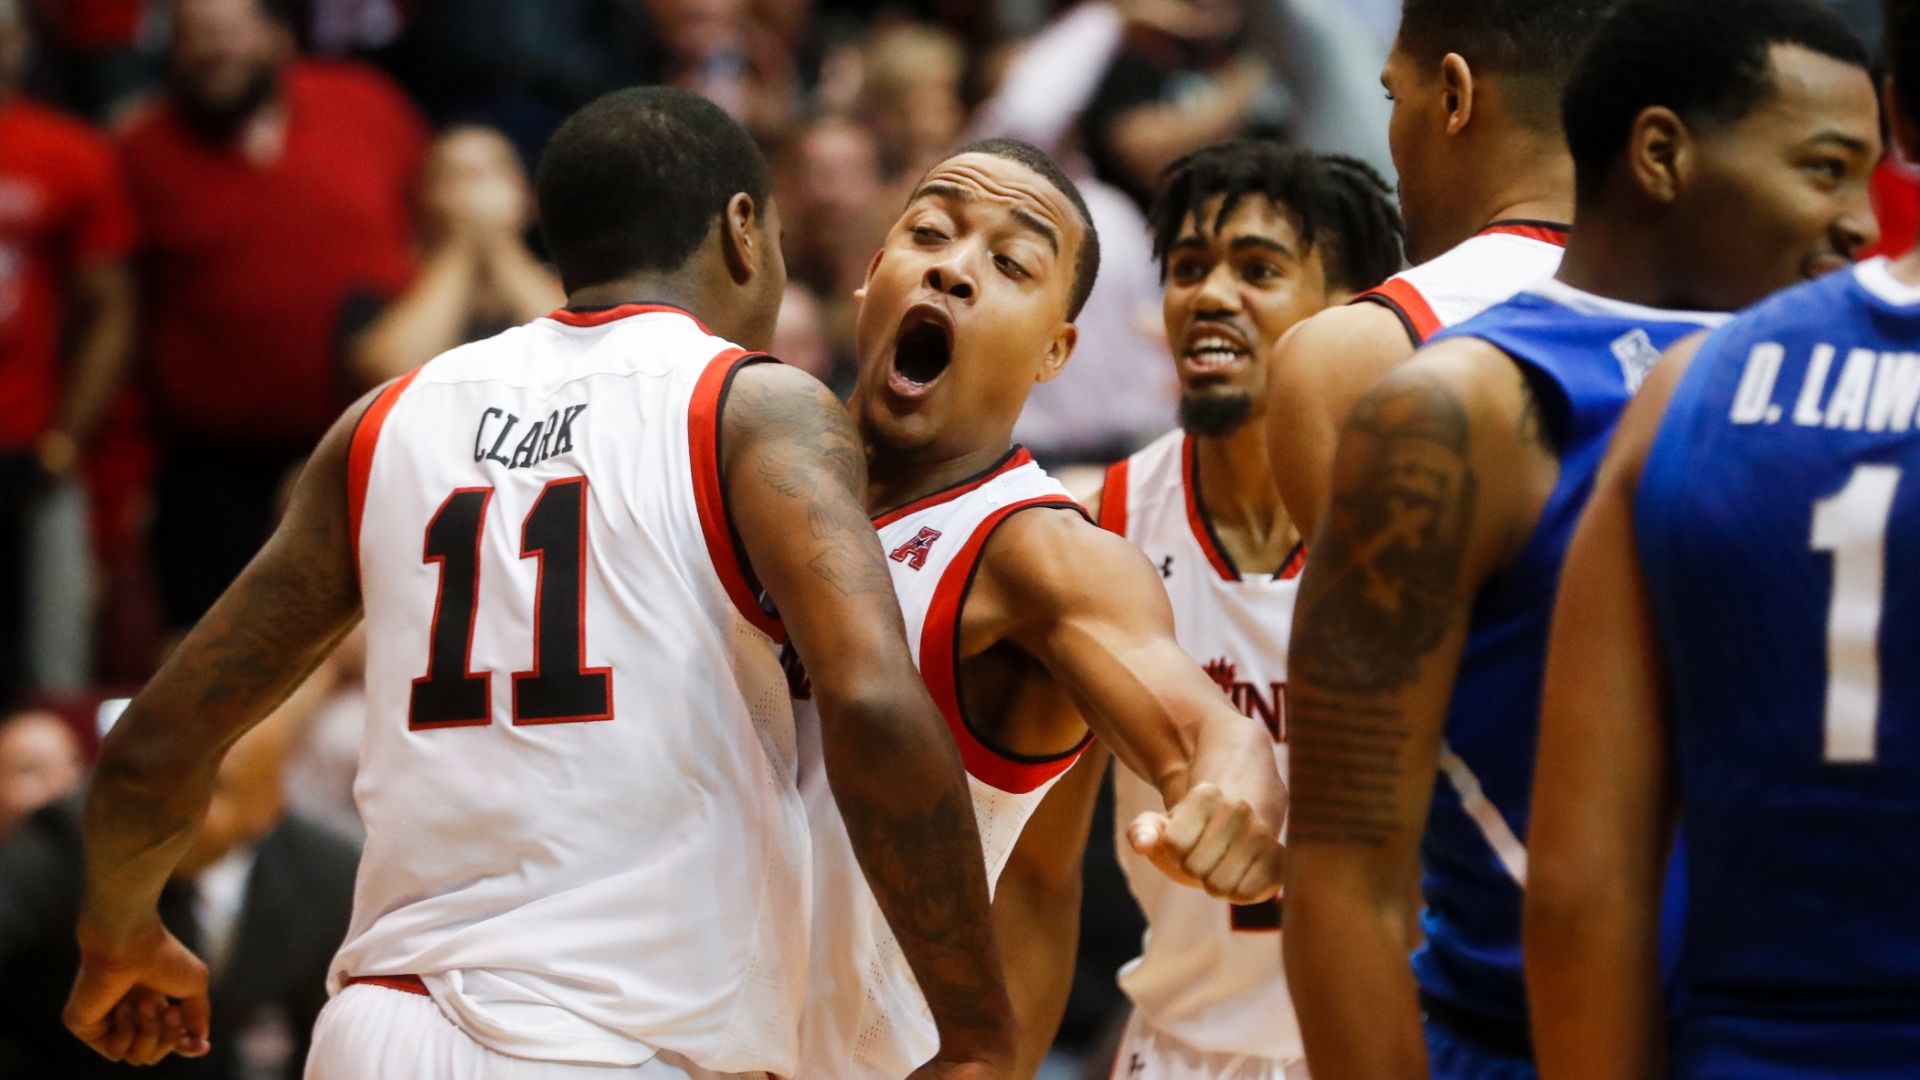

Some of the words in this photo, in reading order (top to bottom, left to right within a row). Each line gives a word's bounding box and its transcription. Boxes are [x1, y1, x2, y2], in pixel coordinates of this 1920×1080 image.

[1728, 341, 1786, 426] D.
[1792, 342, 1920, 434] LAW
[474, 403, 588, 470] CLARK
[889, 526, 943, 572] A
[408, 474, 615, 732] 11
[1810, 464, 1902, 764] 1
